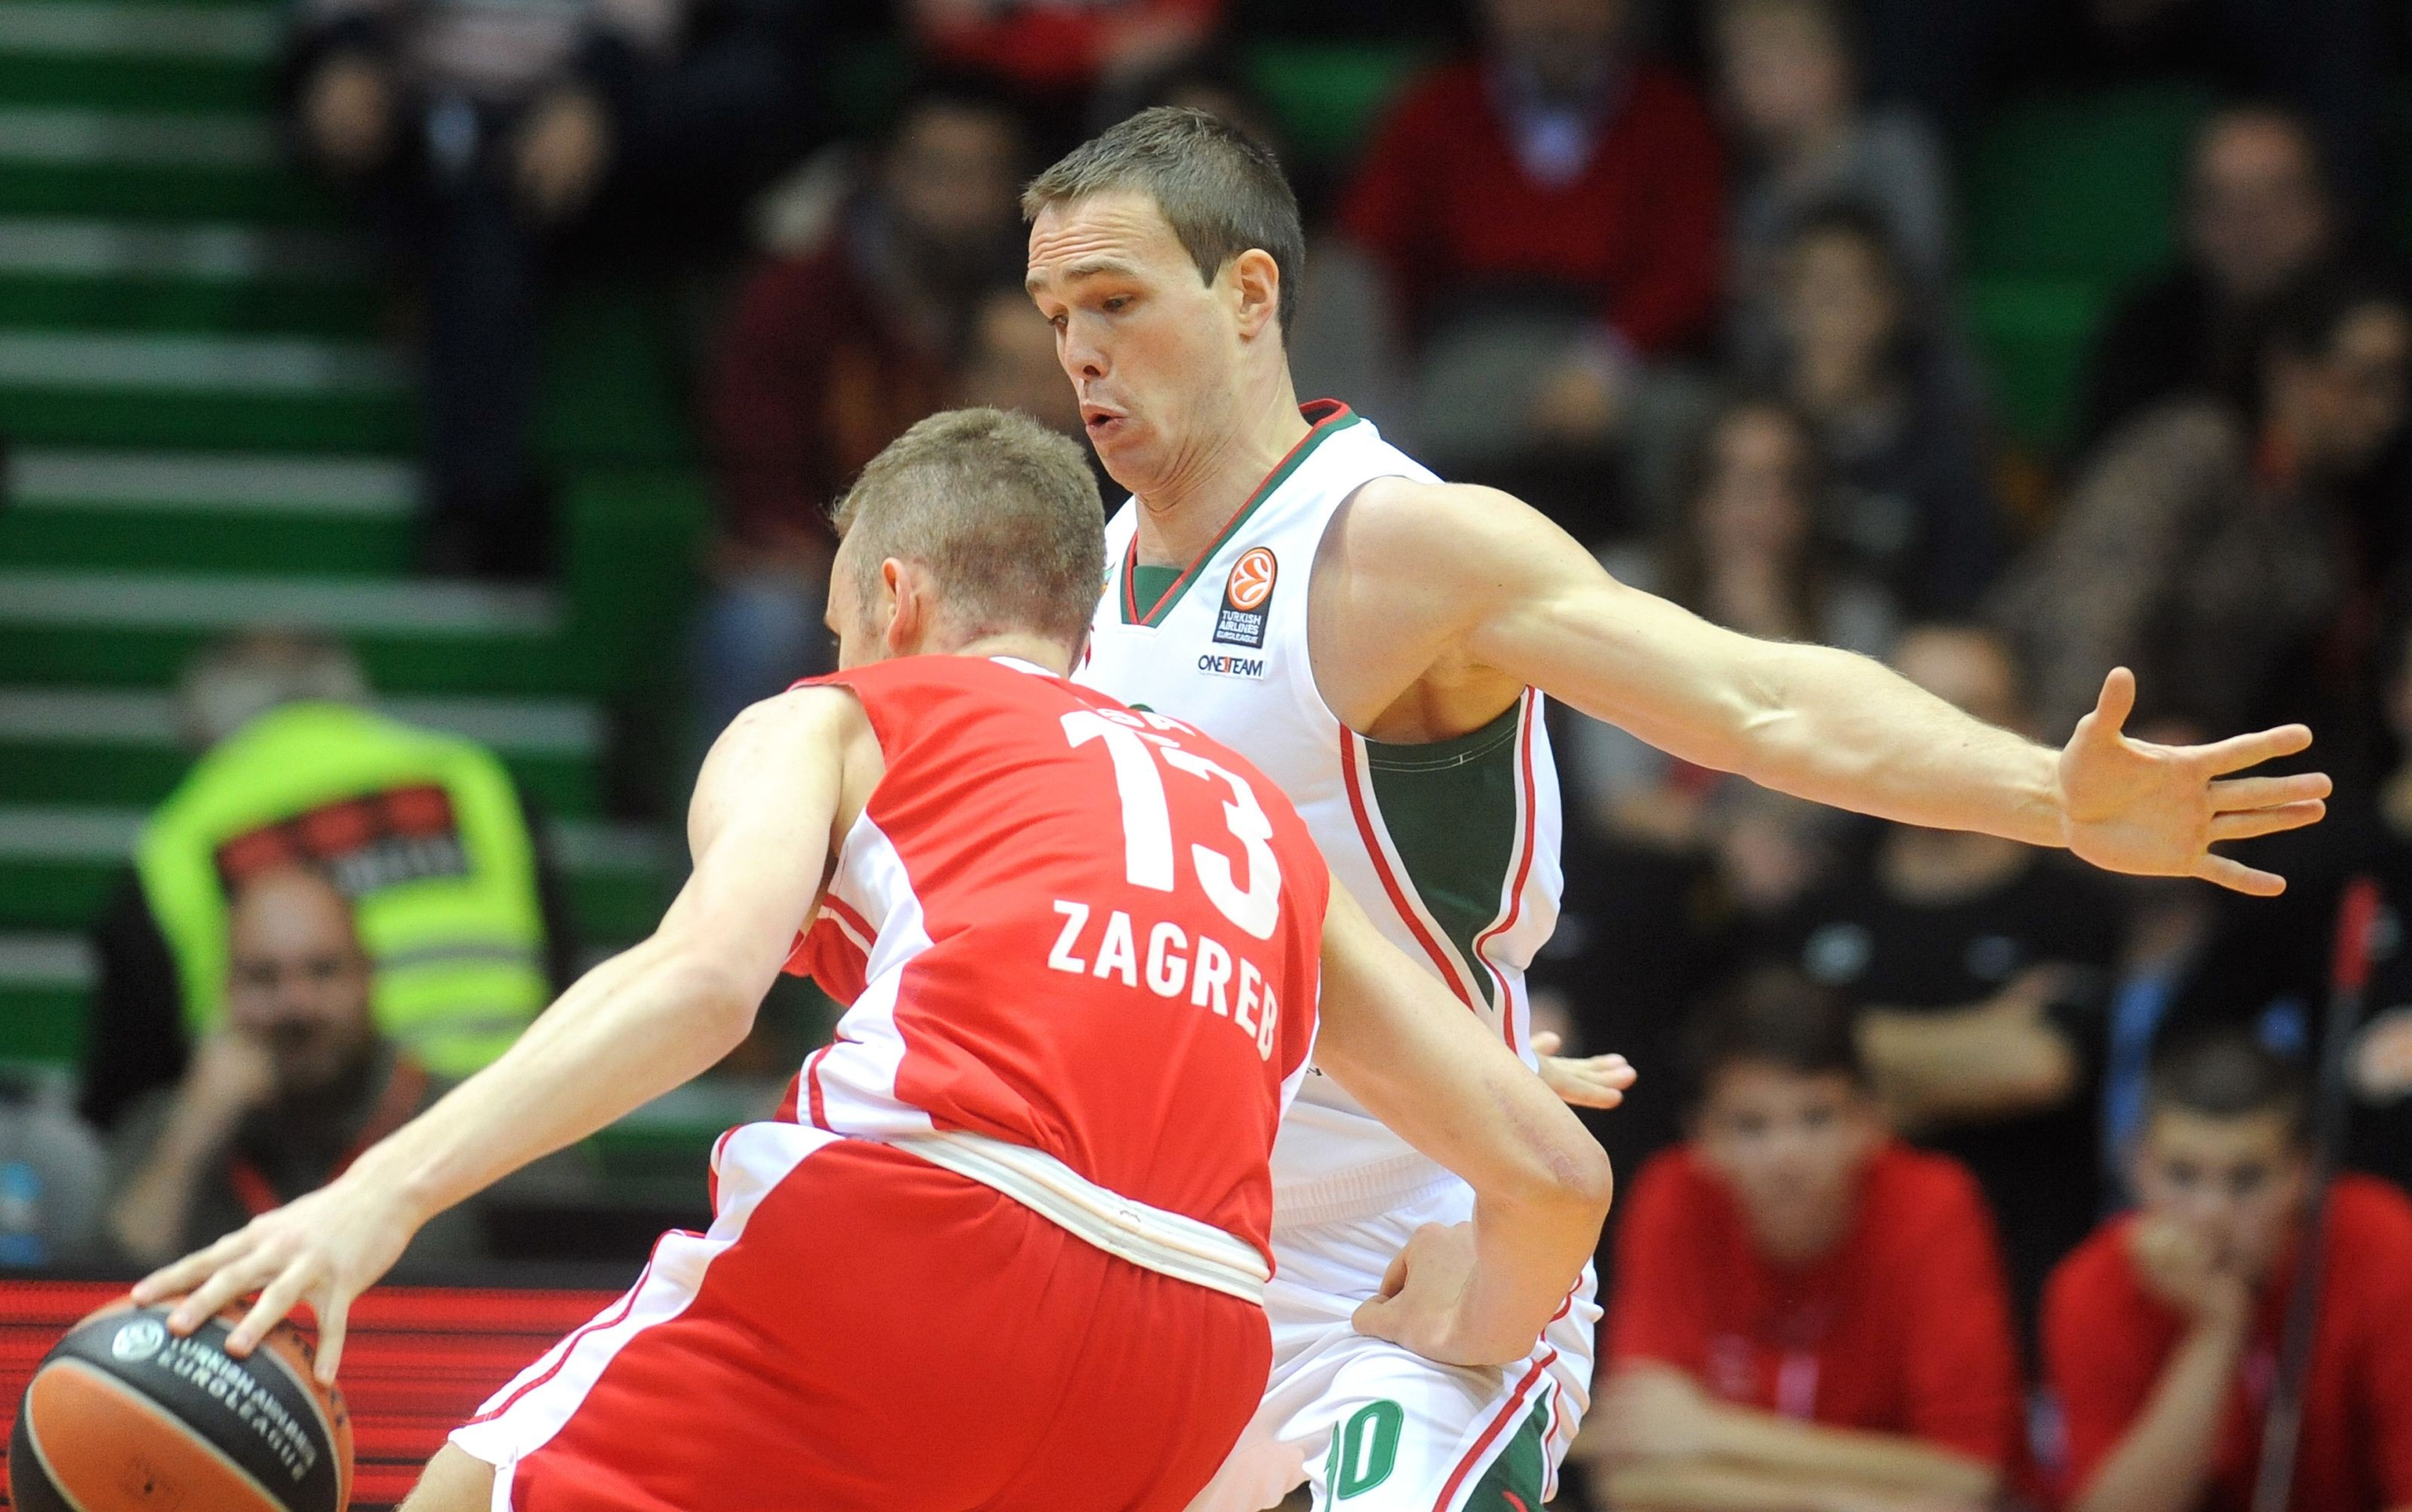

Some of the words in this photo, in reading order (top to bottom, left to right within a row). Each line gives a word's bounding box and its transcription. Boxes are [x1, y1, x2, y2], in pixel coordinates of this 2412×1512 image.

[1218, 620, 1260, 635] AIRLINES
[1222, 611, 1262, 626] TURKISH
[1060, 709, 1281, 940] 13
[1048, 898, 1278, 1061] ZAGREB
[156, 1348, 305, 1483] EUROLEAGUE
